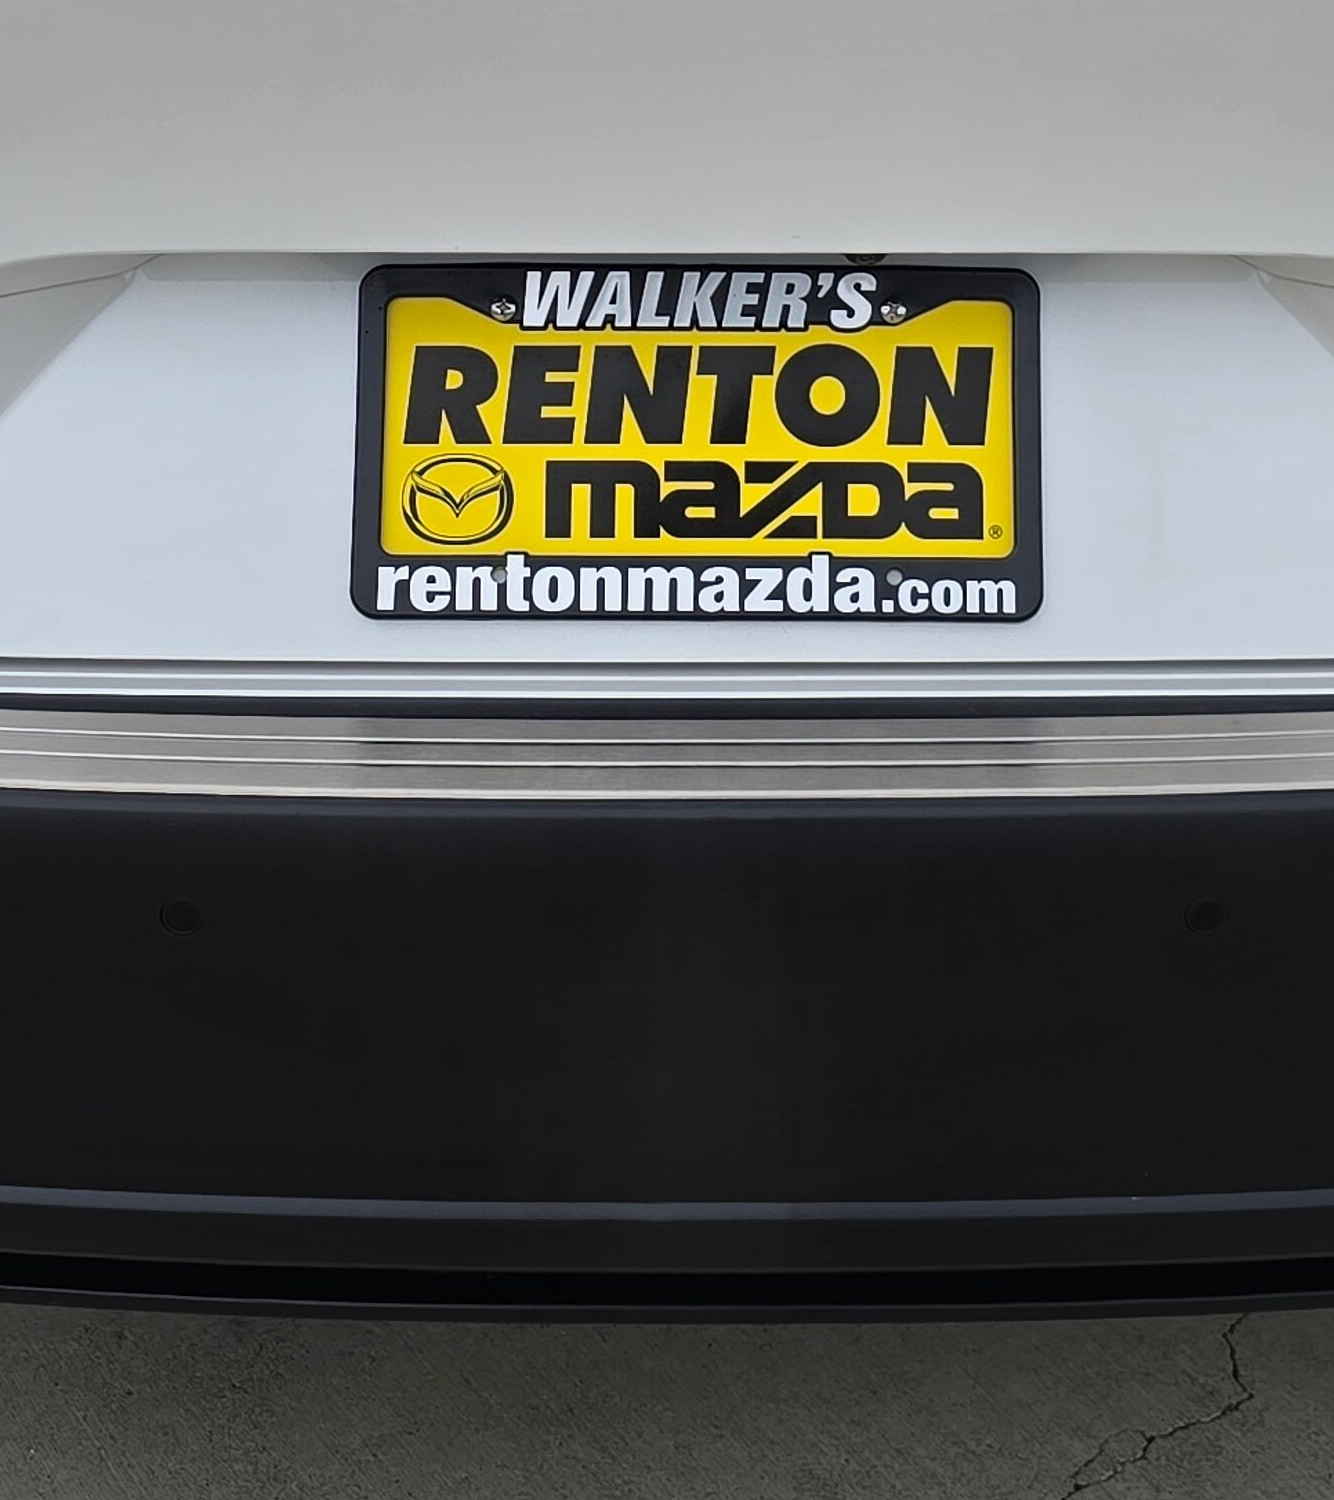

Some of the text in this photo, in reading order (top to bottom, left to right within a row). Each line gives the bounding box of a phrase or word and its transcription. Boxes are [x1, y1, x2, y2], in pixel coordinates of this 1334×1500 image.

[522, 269, 878, 331] WALKER'S
[403, 343, 995, 448] RENTON
[376, 553, 1017, 615] rentonmazda.com
